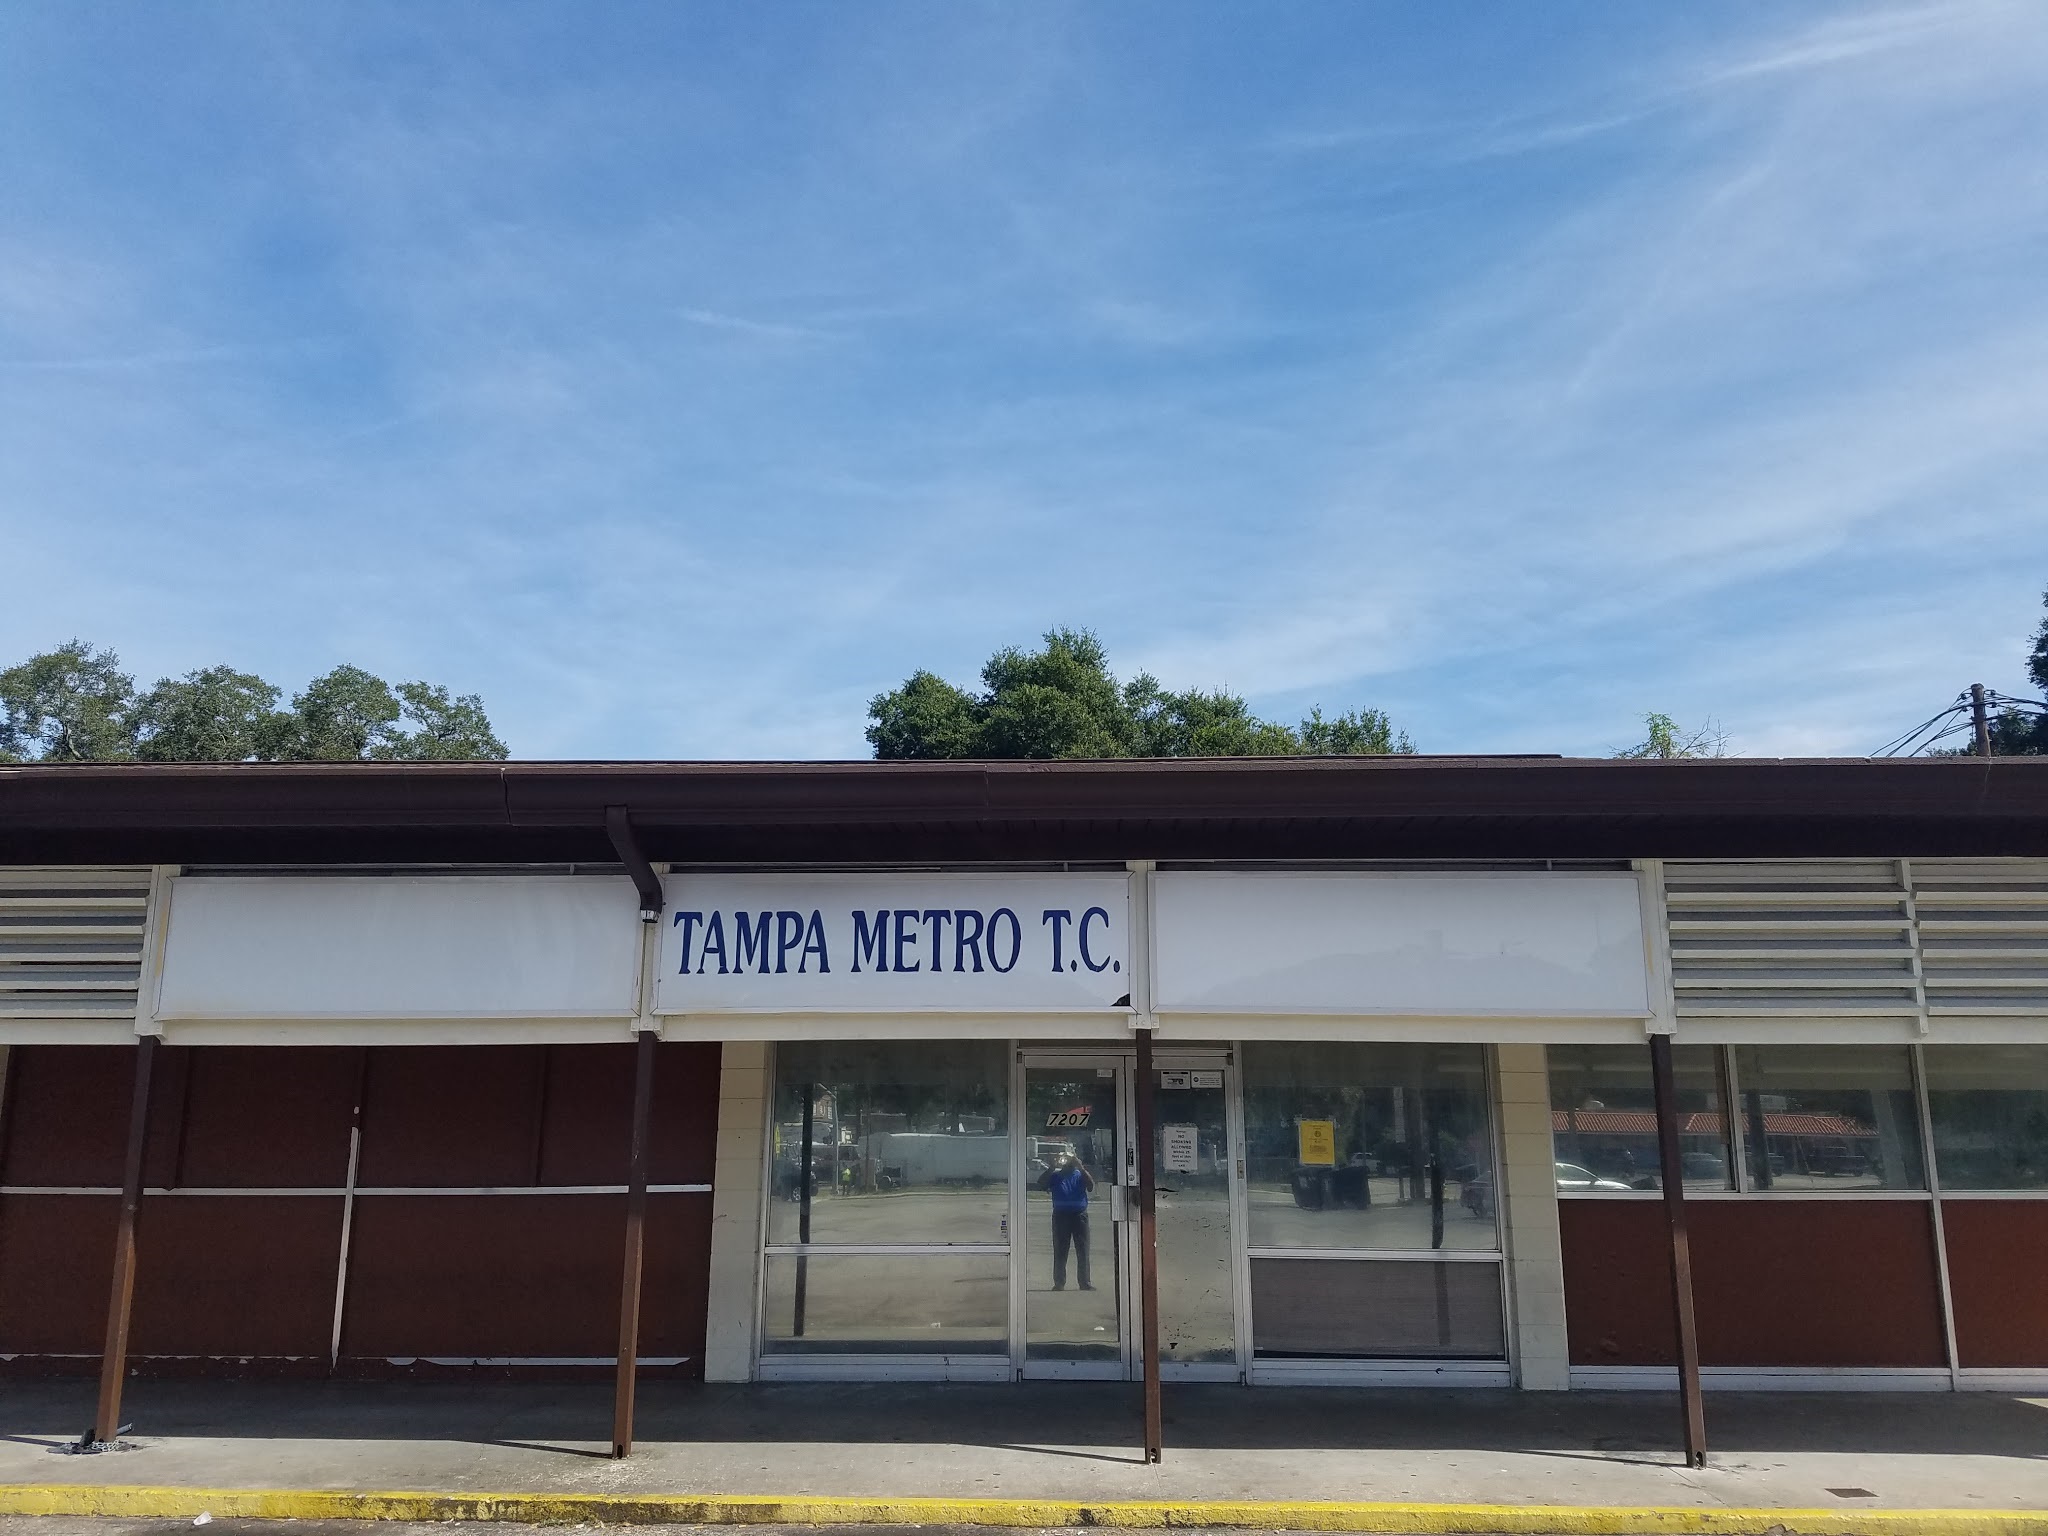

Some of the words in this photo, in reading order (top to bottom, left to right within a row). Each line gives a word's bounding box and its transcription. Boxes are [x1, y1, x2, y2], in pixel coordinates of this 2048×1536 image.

[673, 909, 830, 974] TAMPA
[851, 908, 1021, 973] METRO
[1042, 907, 1121, 973] T.C.
[1049, 1113, 1090, 1126] 7207
